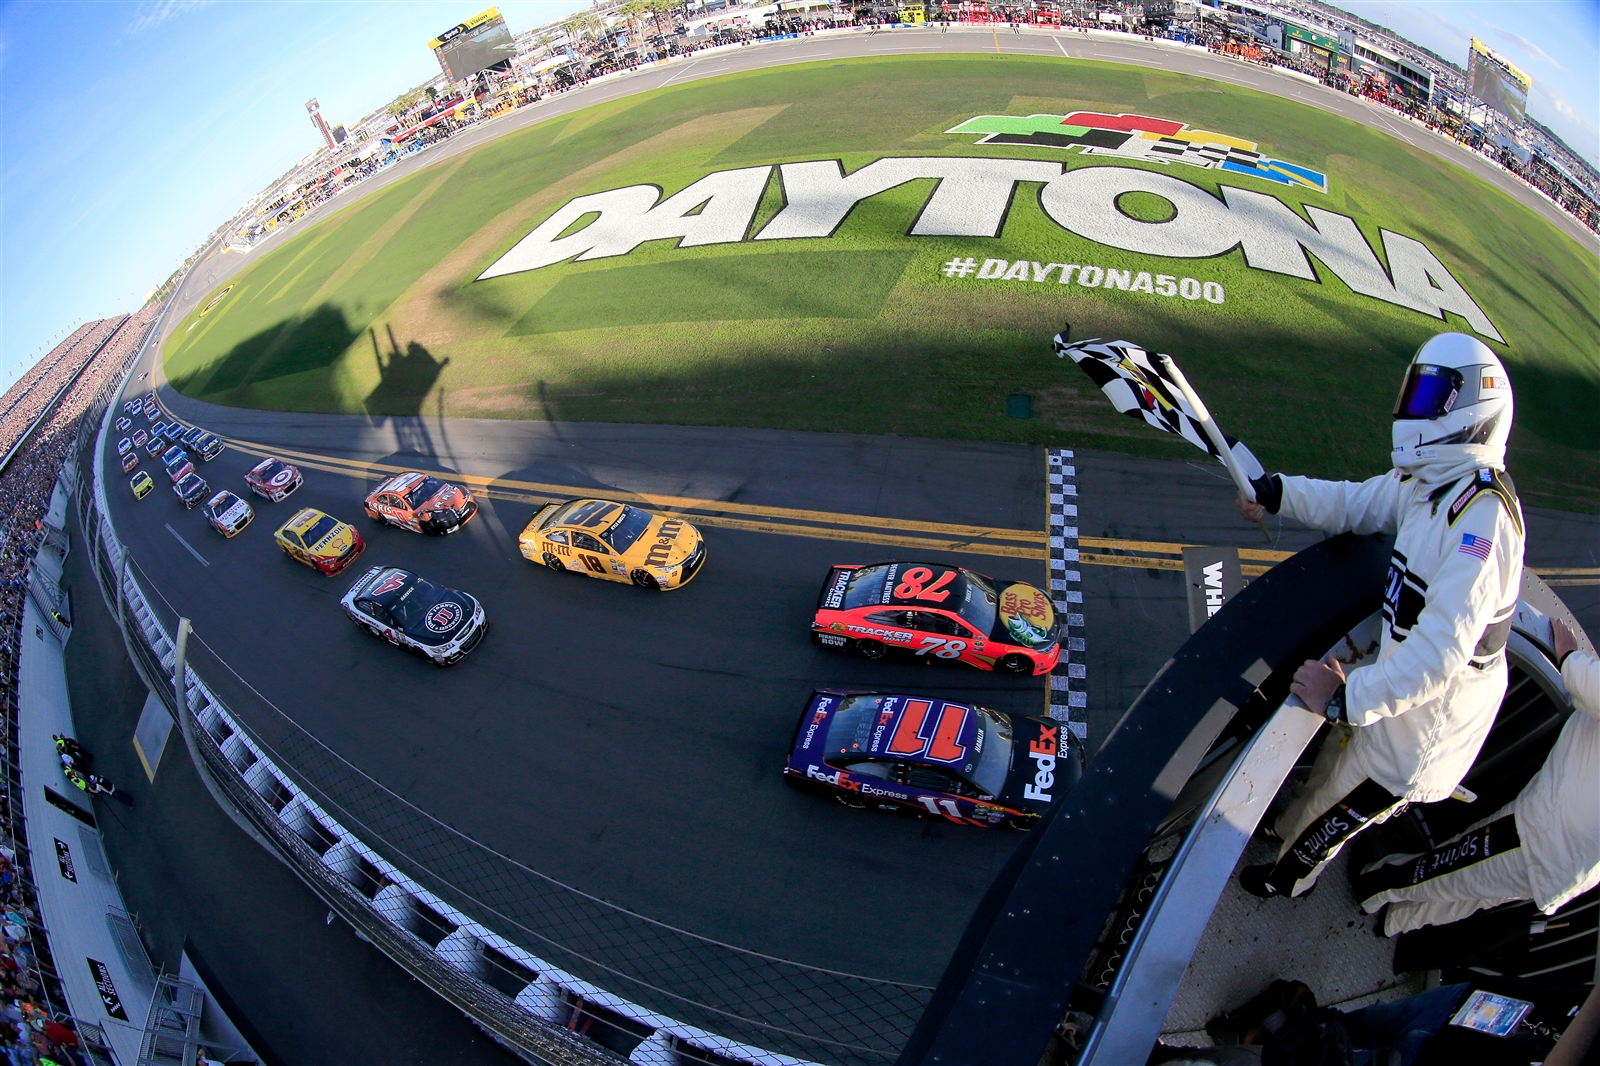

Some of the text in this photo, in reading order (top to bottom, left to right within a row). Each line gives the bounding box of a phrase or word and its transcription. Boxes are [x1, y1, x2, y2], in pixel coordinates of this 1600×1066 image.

[444, 28, 460, 40] Sprint
[477, 157, 1504, 343] DAYTONA
[942, 256, 1226, 305] #DAYTONA500
[1453, 486, 1476, 513] SIMPSON
[564, 501, 621, 528] 18
[314, 525, 345, 552] PENNZOIL
[577, 553, 607, 574] 18
[371, 572, 408, 597] 4
[824, 587, 835, 607] boats
[830, 570, 852, 608] TRACKER
[881, 581, 894, 604] MATTRESS
[893, 566, 957, 603] 78
[433, 608, 454, 626] JJ
[1001, 591, 1018, 616] Bass
[1016, 598, 1031, 618] Pro
[1030, 591, 1050, 621] Shops
[818, 633, 847, 642] FURNITURE
[821, 638, 844, 646] ROW
[847, 624, 914, 639] TRACKER
[915, 636, 967, 659] 78
[802, 697, 833, 749] FedEx Express
[870, 697, 898, 752] FedEx Express
[884, 698, 970, 764] 11
[974, 728, 985, 754] HAMLIN
[1057, 726, 1069, 759] Express
[1023, 724, 1059, 803] FedEx
[806, 764, 909, 800] FedEx Express
[917, 796, 964, 818] 11
[1347, 808, 1368, 823] NASCAR
[1304, 816, 1349, 858] Sprint
[1432, 834, 1478, 870] Sprint
[96, 981, 108, 993] ALL
[98, 964, 117, 996] SECTIONS
